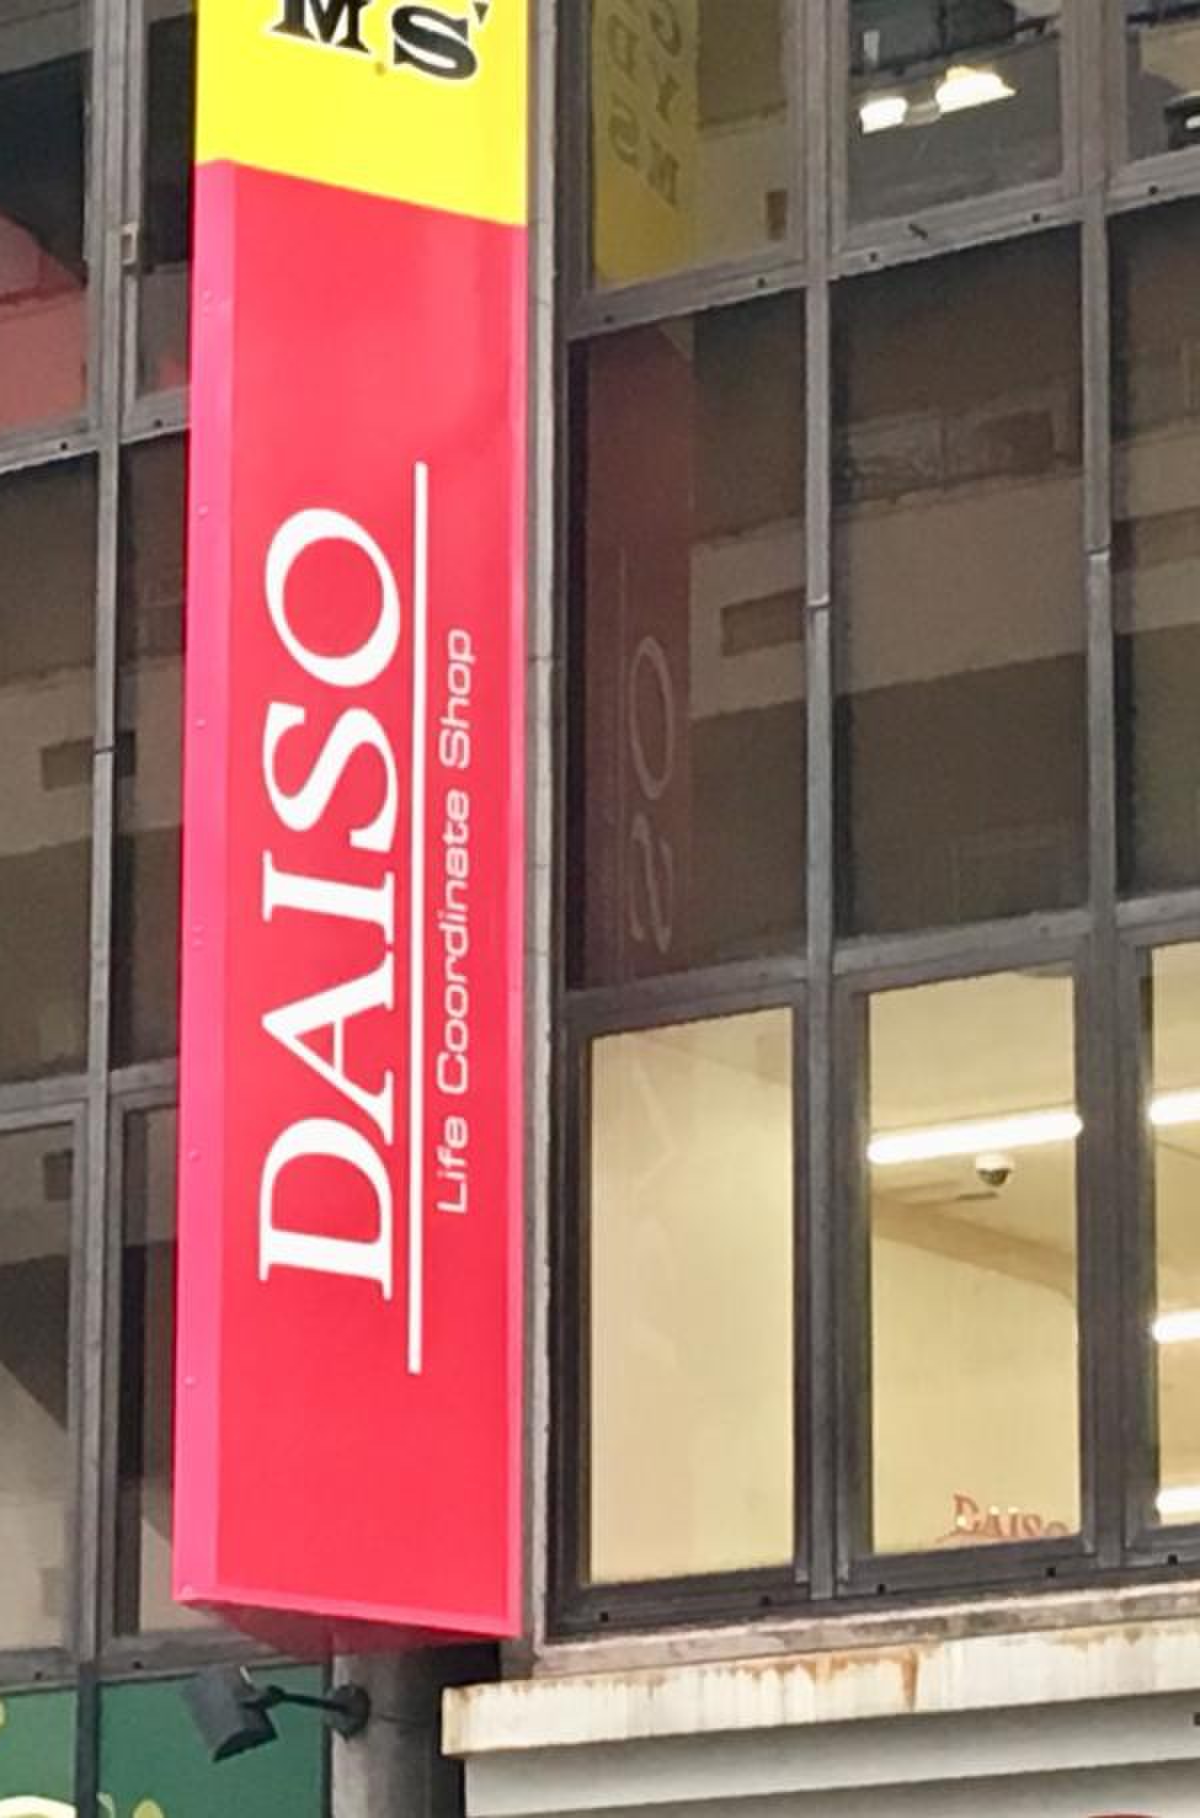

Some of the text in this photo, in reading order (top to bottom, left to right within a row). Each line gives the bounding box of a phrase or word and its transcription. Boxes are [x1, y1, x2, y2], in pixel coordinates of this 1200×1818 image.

[258, 507, 402, 1300] DAISO
[436, 628, 476, 1214] Life Coordinate Shop
